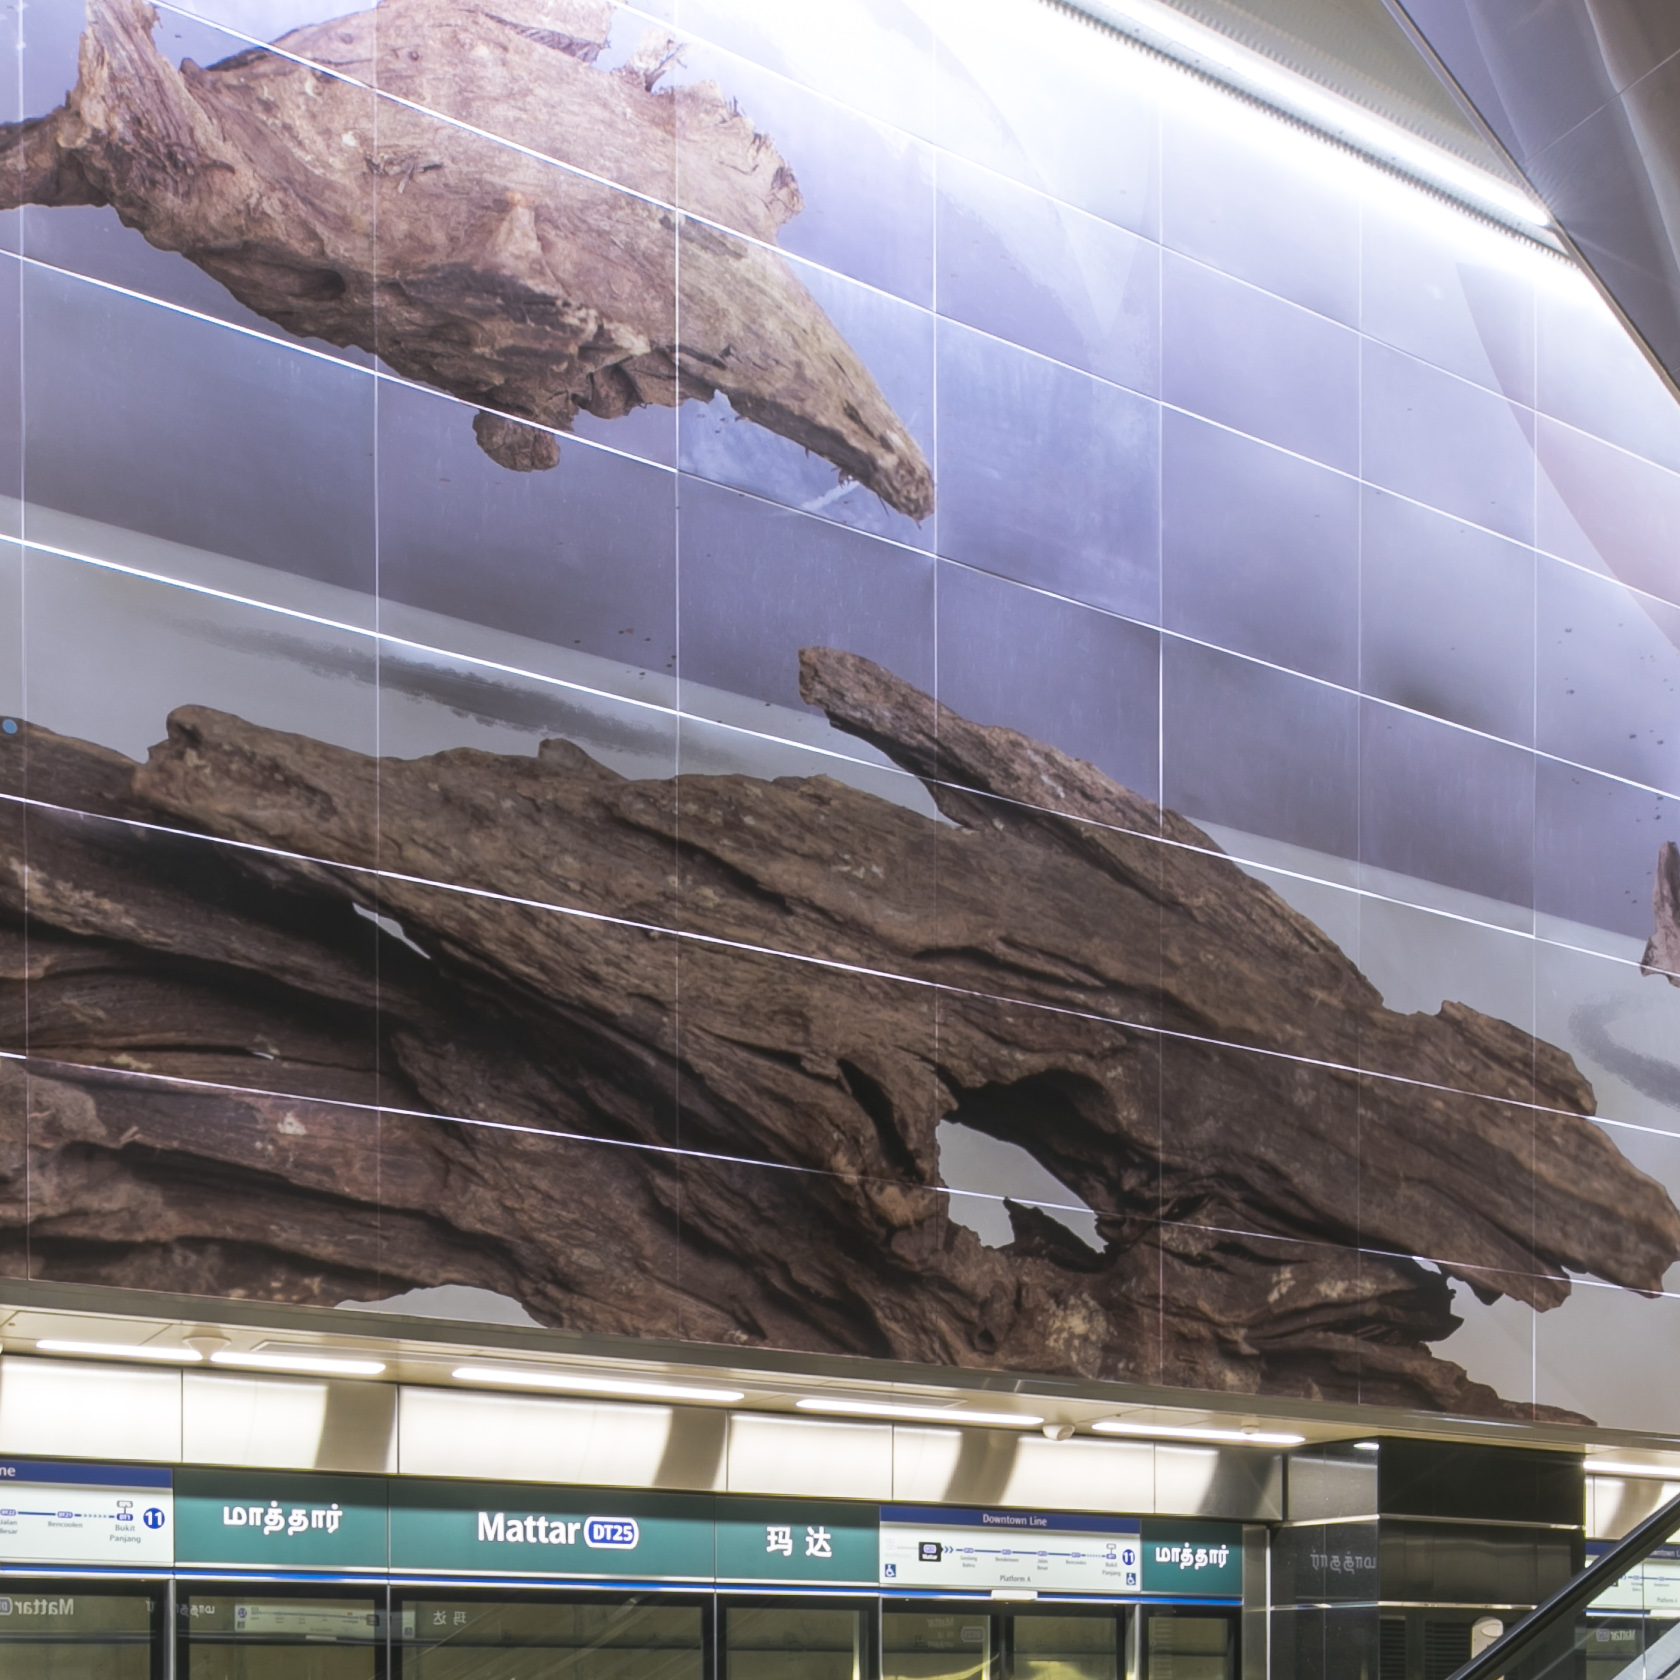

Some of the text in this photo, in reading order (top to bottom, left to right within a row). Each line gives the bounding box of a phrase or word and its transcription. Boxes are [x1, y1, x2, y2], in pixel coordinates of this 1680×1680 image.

[115, 1524, 135, 1532] Bukit
[144, 1511, 163, 1526] 11
[223, 1500, 343, 1536] மாத்தார்
[477, 1510, 634, 1545] Mattar DT25
[983, 1513, 1047, 1526] Downtown Line
[110, 1535, 141, 1543] Panjang
[765, 1525, 833, 1559] 玛达
[1155, 1541, 1229, 1570] மாத்தார்
